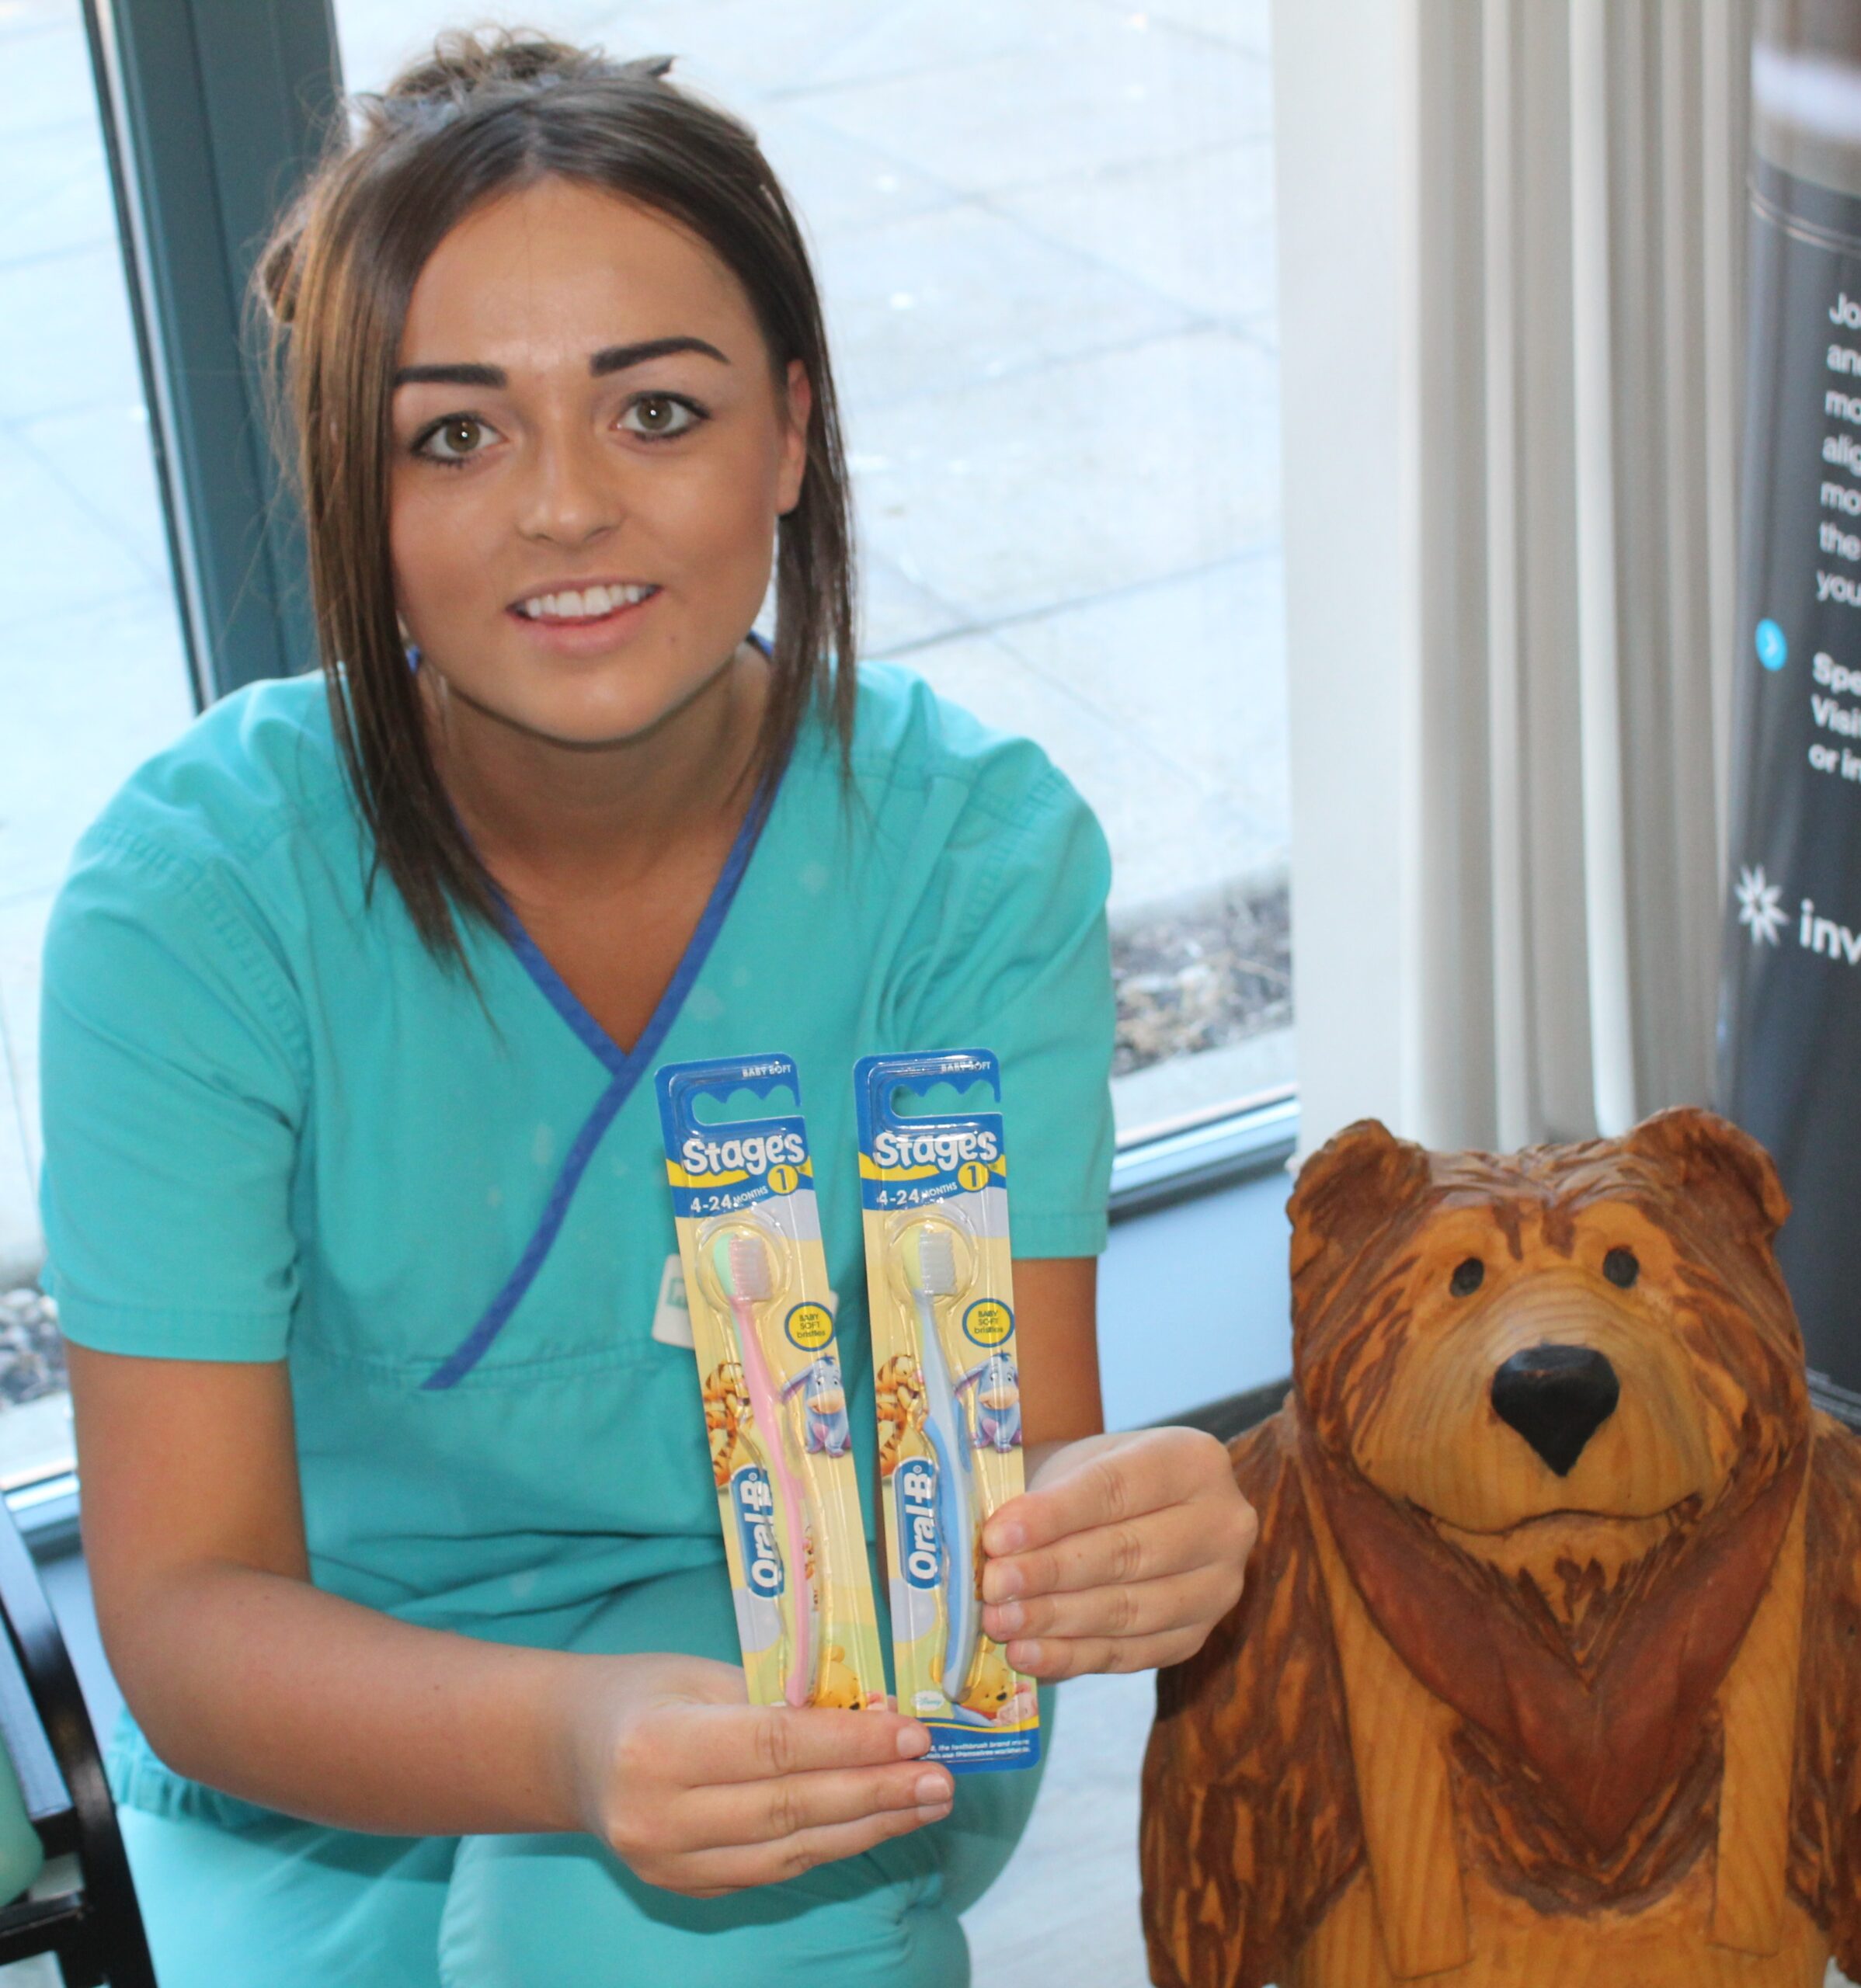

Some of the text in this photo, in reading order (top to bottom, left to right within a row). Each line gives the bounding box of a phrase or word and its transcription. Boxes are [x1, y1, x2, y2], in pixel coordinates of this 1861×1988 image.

[1827, 344, 1861, 377] an
[1811, 693, 1861, 739] Visi
[1808, 744, 1839, 773] or
[741, 1064, 791, 1078] BABY SOFT
[682, 1133, 805, 1175] Stages
[872, 1131, 998, 1171] Stages
[776, 1168, 787, 1190] 1
[968, 1165, 977, 1188] 1
[690, 1185, 769, 1212] 4-24 MONTHS
[876, 1182, 958, 1206] 4-24 MONTHS
[739, 1479, 783, 1588] Oral-B
[903, 1472, 938, 1580] Oral-B
